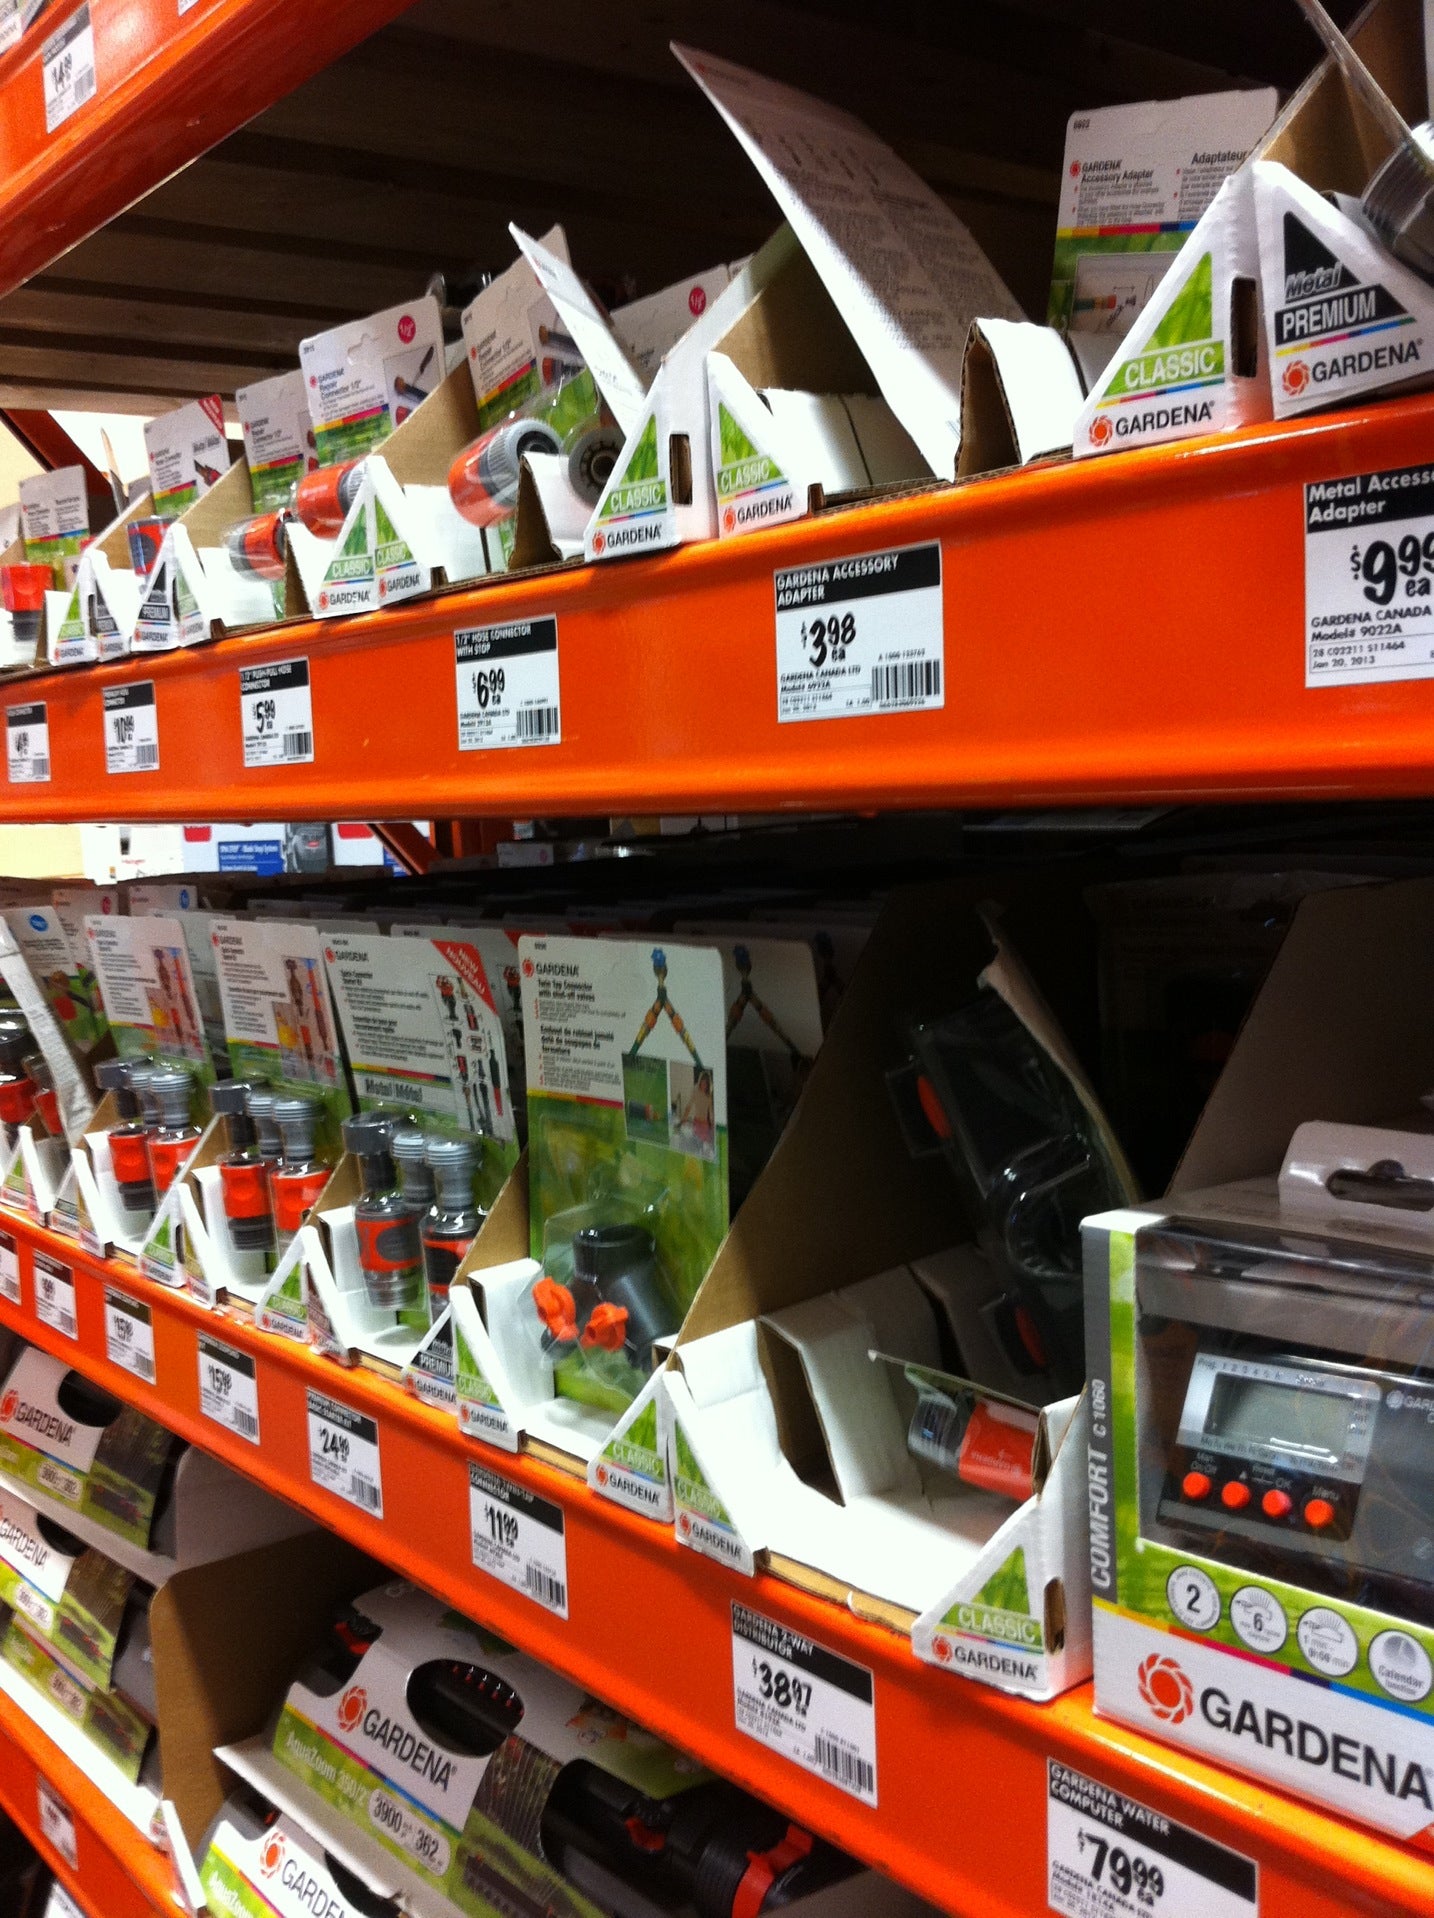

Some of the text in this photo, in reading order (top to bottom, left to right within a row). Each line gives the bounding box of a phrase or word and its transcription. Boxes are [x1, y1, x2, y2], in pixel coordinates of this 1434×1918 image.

[1191, 150, 1248, 165] Adaptateur
[1081, 172, 1121, 184] Accessory
[1286, 262, 1343, 299] Metal
[1283, 290, 1376, 340] PREMIUM
[1124, 346, 1217, 389] CLASSIC
[1312, 339, 1420, 382] GARDENA
[1116, 402, 1212, 436] GARDENA
[720, 460, 770, 492] CLASSIC
[1308, 476, 1361, 503] Metal
[610, 484, 662, 512] CLASSIC
[737, 499, 792, 522] GARDENA
[1308, 500, 1386, 523] Adapter
[607, 528, 660, 548] GARDENA
[331, 558, 370, 578] CLASSIC
[777, 553, 899, 591] GARDENA ACCESSORY
[329, 582, 371, 606] GARDENA
[777, 584, 825, 608] ADAPTER
[1405, 577, 1430, 598] ea
[1311, 605, 1431, 628] GARDENA CANADA
[1311, 623, 1402, 642] Model# 9022A
[536, 963, 579, 976] GARDENA
[16, 1402, 76, 1446] GARDENA
[612, 1442, 664, 1473] CLASSIC
[609, 1473, 659, 1506] GARDENA
[1088, 1443, 1111, 1589] COMFORT
[0, 1519, 48, 1569] GARDENA
[692, 1521, 741, 1561] GARDENA
[1185, 1583, 1200, 1613] 2
[957, 1605, 1036, 1643] CLASSIC
[1253, 1613, 1263, 1632] 6
[955, 1645, 1037, 1681] GARDENA
[362, 1709, 451, 1792] GARDENA
[1199, 1686, 1434, 1812] GARDENA
[1051, 1763, 1171, 1837] GARDENA WATER
[1051, 1780, 1124, 1829] COMPUTER
[374, 1797, 440, 1864] 3900 362
[281, 1857, 347, 1918] GARDE
